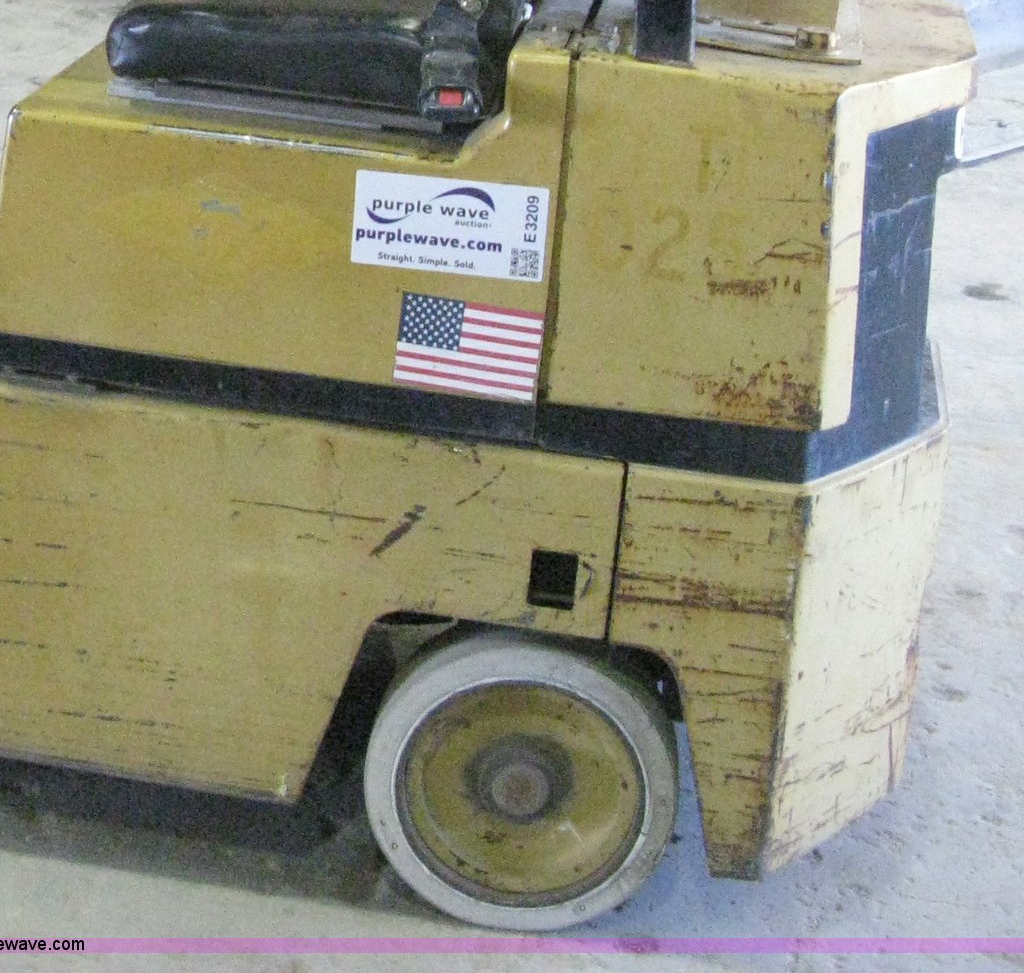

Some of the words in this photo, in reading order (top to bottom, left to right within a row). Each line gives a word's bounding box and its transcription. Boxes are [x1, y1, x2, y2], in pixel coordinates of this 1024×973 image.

[372, 197, 433, 215] purple
[440, 205, 490, 220] wave
[523, 195, 540, 243] E3209
[355, 228, 502, 253] purplewave.com
[377, 252, 415, 264] Straight.
[418, 256, 452, 268] Simple.
